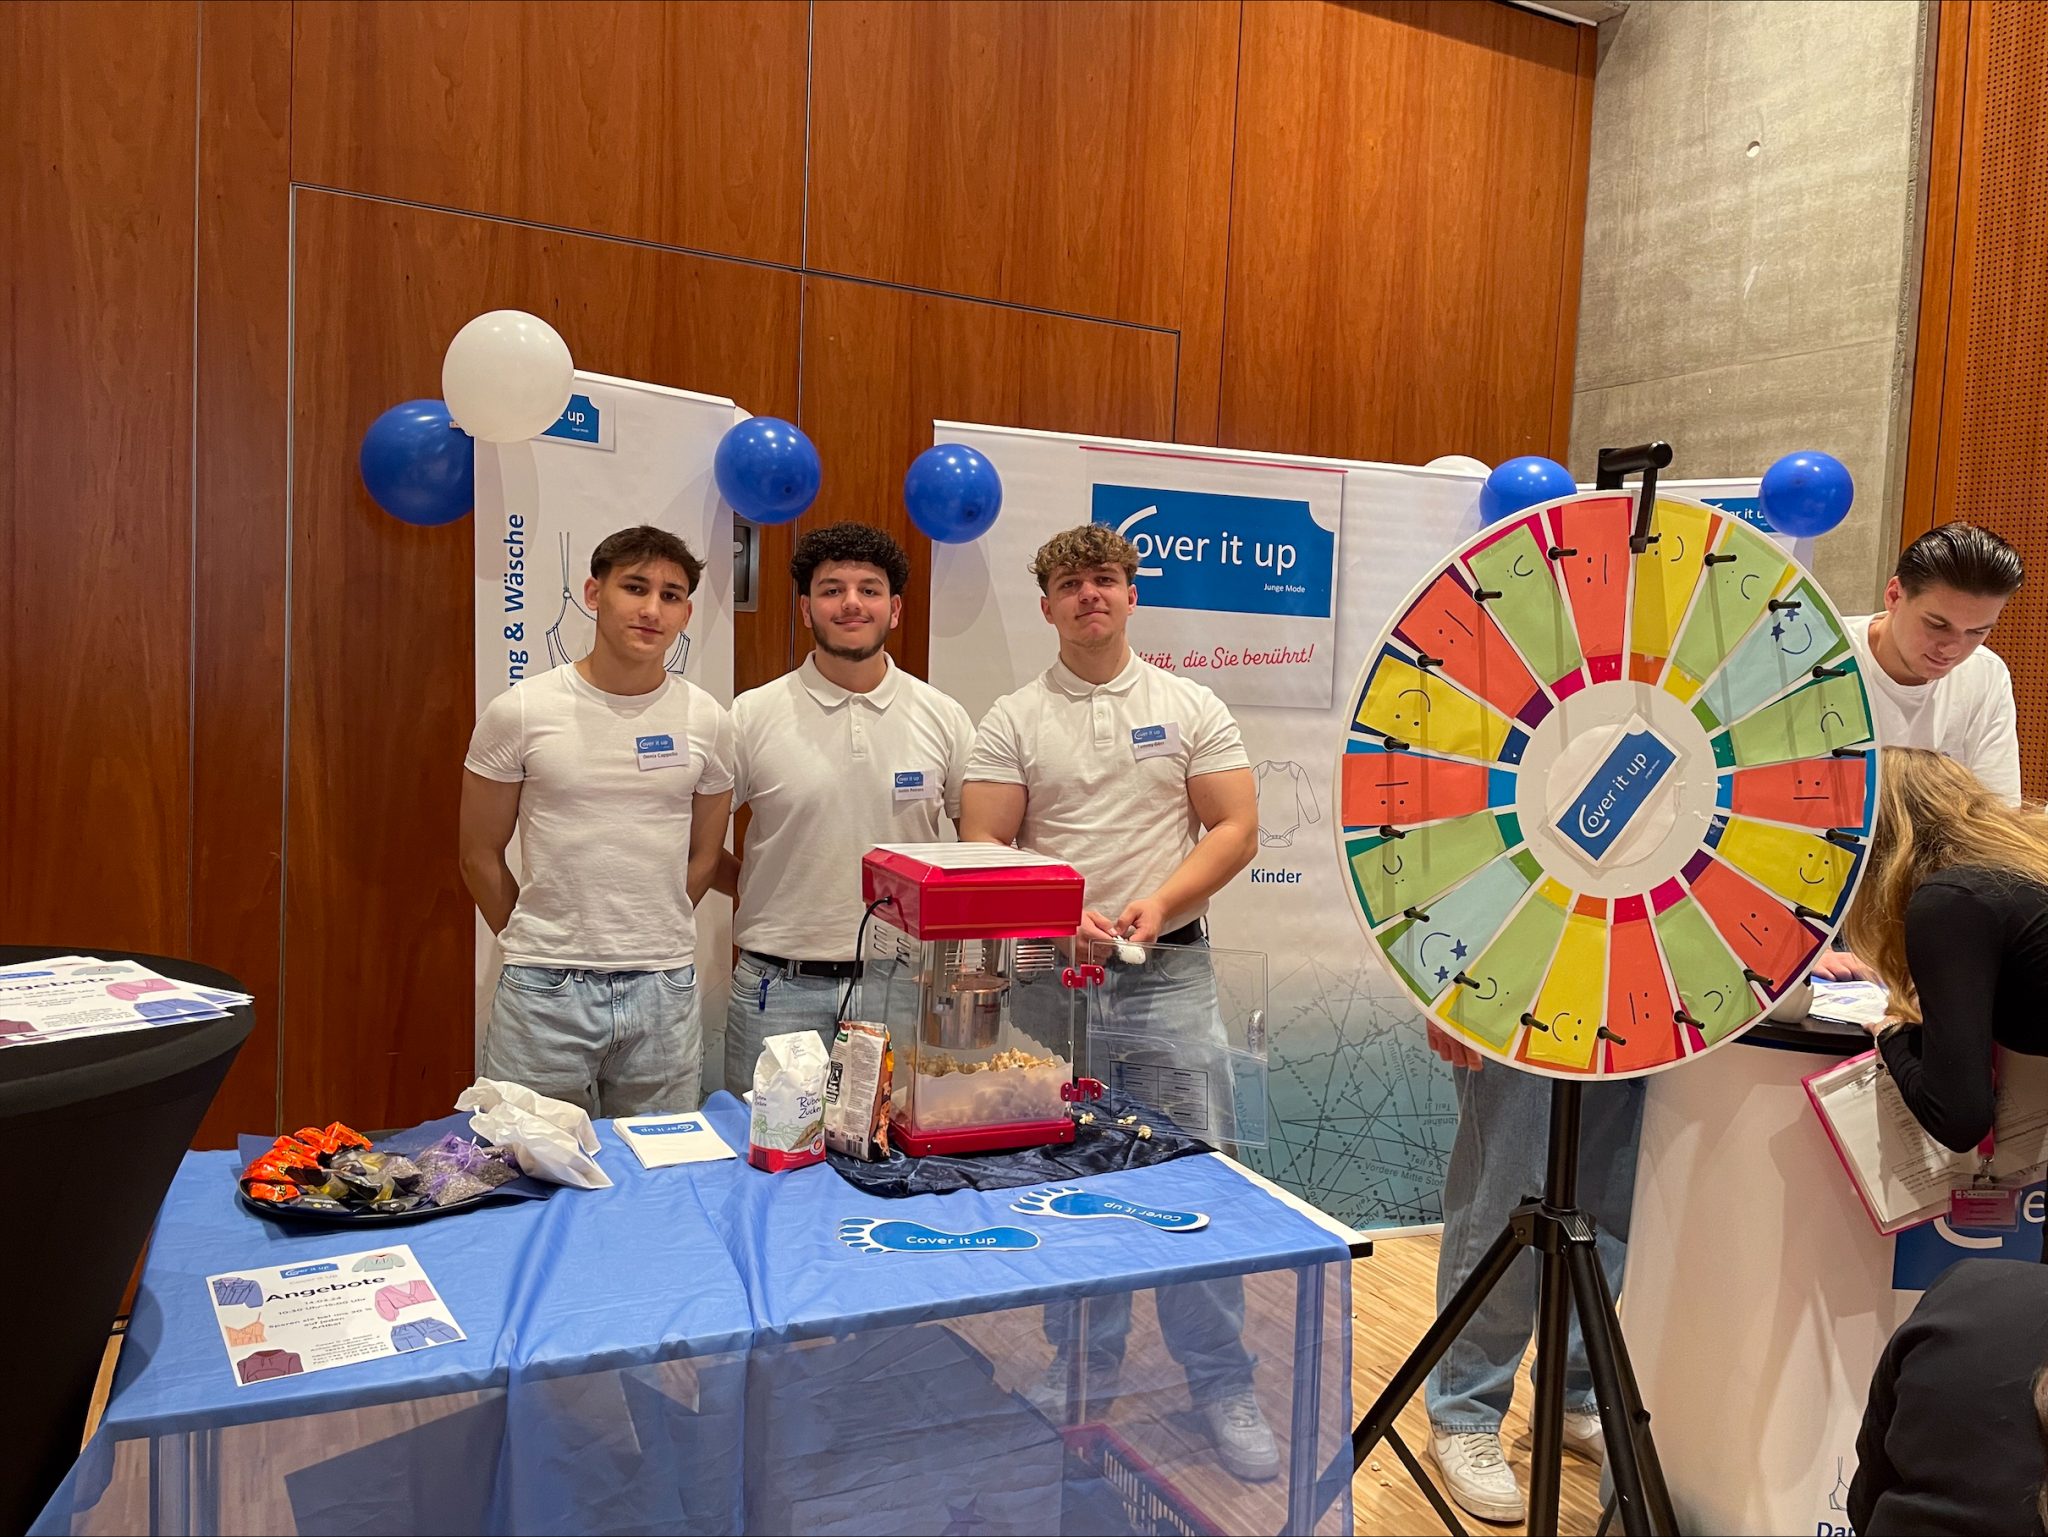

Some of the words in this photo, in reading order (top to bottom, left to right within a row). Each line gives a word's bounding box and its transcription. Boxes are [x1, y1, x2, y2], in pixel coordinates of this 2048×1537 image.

[568, 411, 584, 425] up
[1744, 508, 1753, 519] it
[1221, 531, 1243, 565] it
[1255, 542, 1296, 576] up
[504, 514, 524, 612] Wäsche
[1264, 583, 1284, 593] Junge
[1286, 584, 1306, 593] Mode
[504, 622, 524, 641] &
[1183, 650, 1207, 667] die
[1211, 647, 1239, 669] Sie
[1244, 644, 1315, 666] berührt!
[510, 650, 528, 686] ng
[1579, 790, 1617, 838] Cover
[1612, 775, 1630, 791] it
[1626, 753, 1647, 776] up
[1252, 868, 1302, 883] Kinder
[0, 978, 114, 992] ngebote
[1411, 1154, 1426, 1166] Teil
[1365, 1162, 1399, 1177] Vordere
[1401, 1170, 1423, 1183] Mitte
[1104, 1202, 1122, 1210] up
[1125, 1206, 1136, 1214] it
[1139, 1210, 1182, 1222] Cover
[906, 1236, 954, 1244] Cover
[265, 1277, 386, 1302] Angebote
